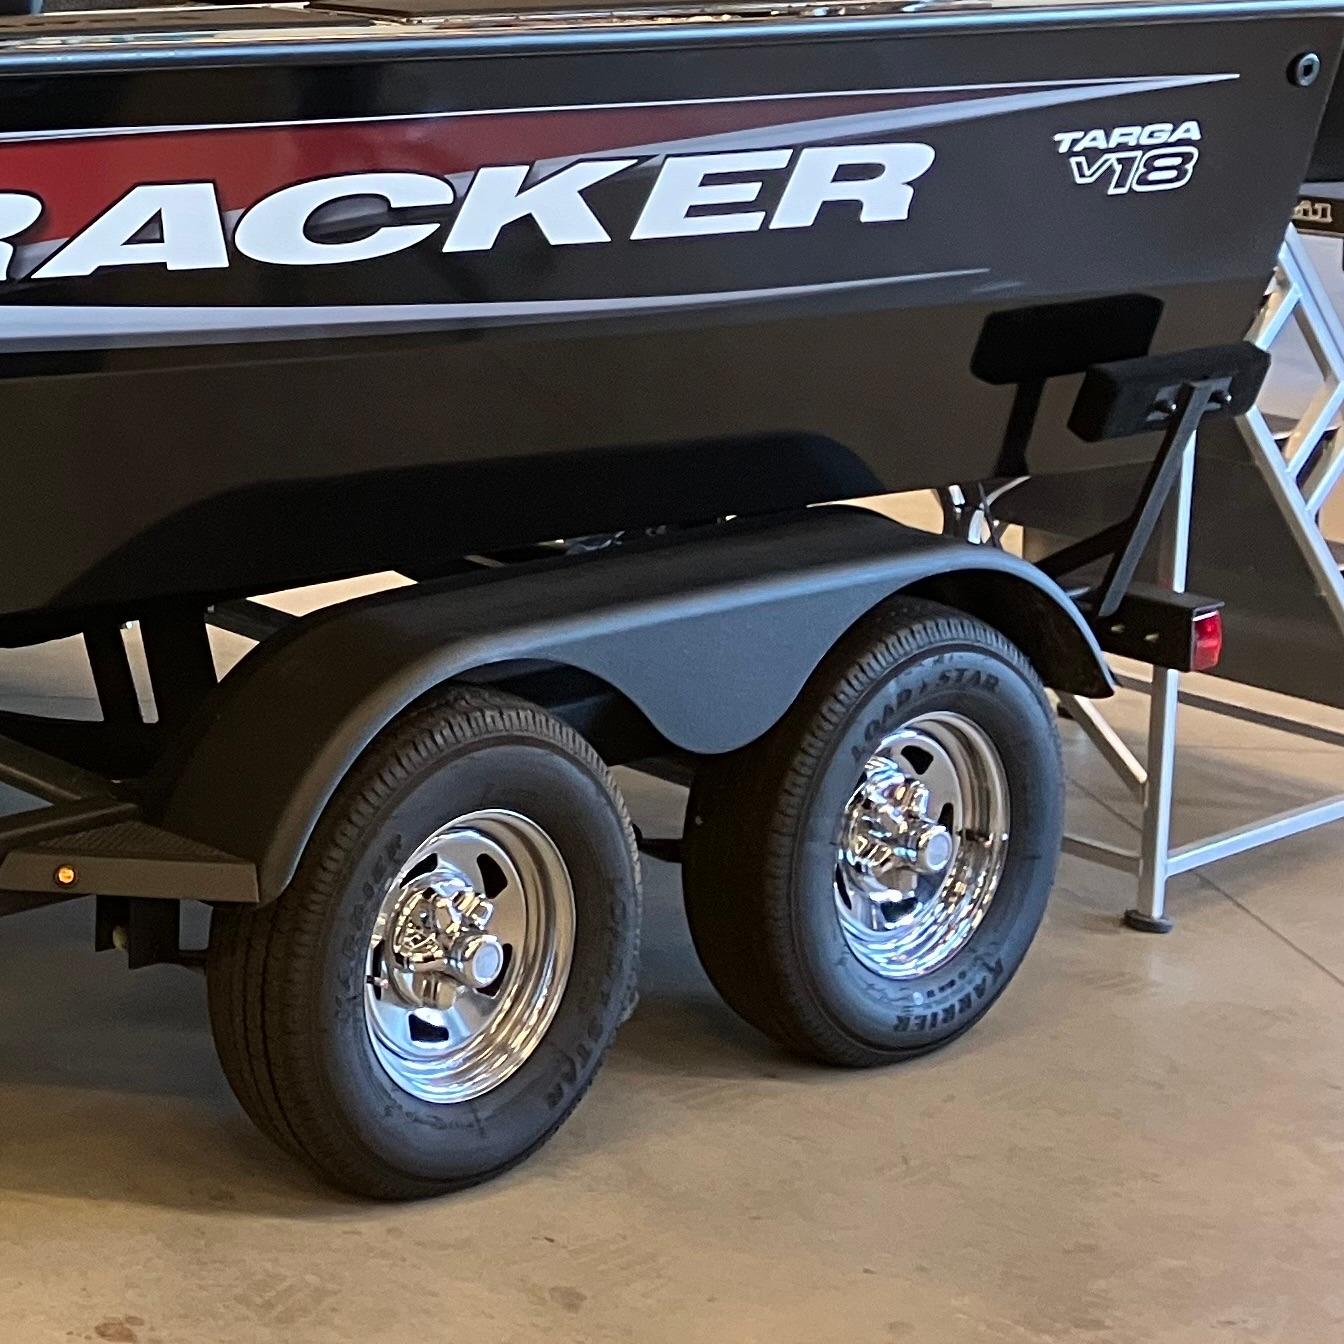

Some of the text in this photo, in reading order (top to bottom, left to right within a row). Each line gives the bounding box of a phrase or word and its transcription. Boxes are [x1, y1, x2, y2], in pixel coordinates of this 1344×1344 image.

[1053, 120, 1202, 154] TARGA
[1069, 145, 1200, 195] V18
[937, 666, 1001, 690] STAR
[892, 957, 1005, 1033] KARRIER
